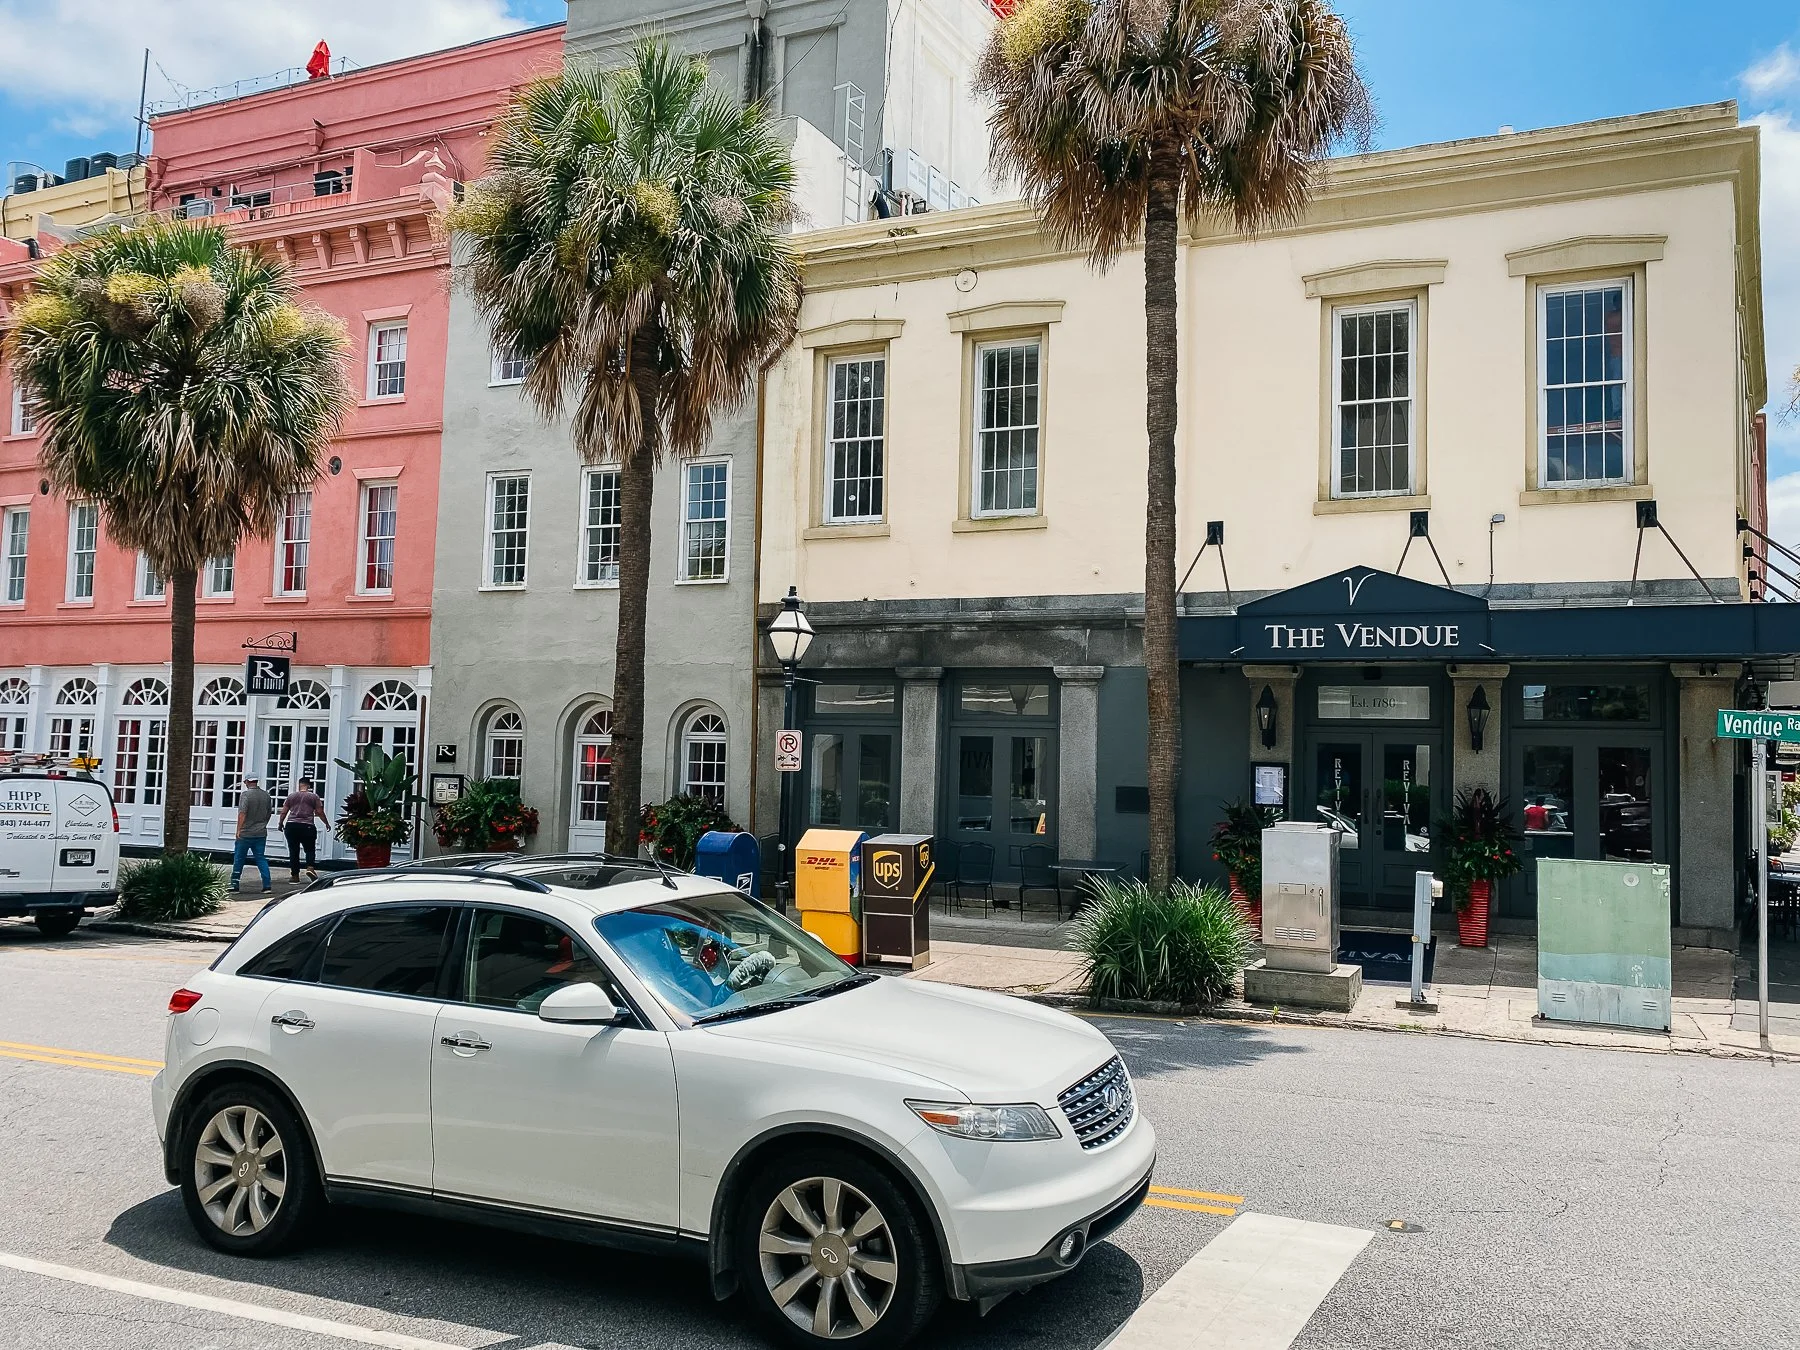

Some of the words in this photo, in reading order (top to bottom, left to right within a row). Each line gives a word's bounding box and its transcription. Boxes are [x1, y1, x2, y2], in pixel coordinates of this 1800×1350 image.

[1264, 624, 1325, 649] THE
[1335, 623, 1460, 648] VENDUE
[253, 660, 285, 679] R
[1723, 713, 1783, 736] Vendue
[438, 745, 455, 756] R
[9, 790, 42, 801] HIPP
[0, 801, 50, 812] SERVICE
[97, 821, 108, 829] SC
[6, 832, 38, 840] Dedicated
[48, 833, 70, 842] Quality
[71, 833, 87, 841] Since
[806, 856, 838, 866] DHL
[875, 861, 900, 882] ups
